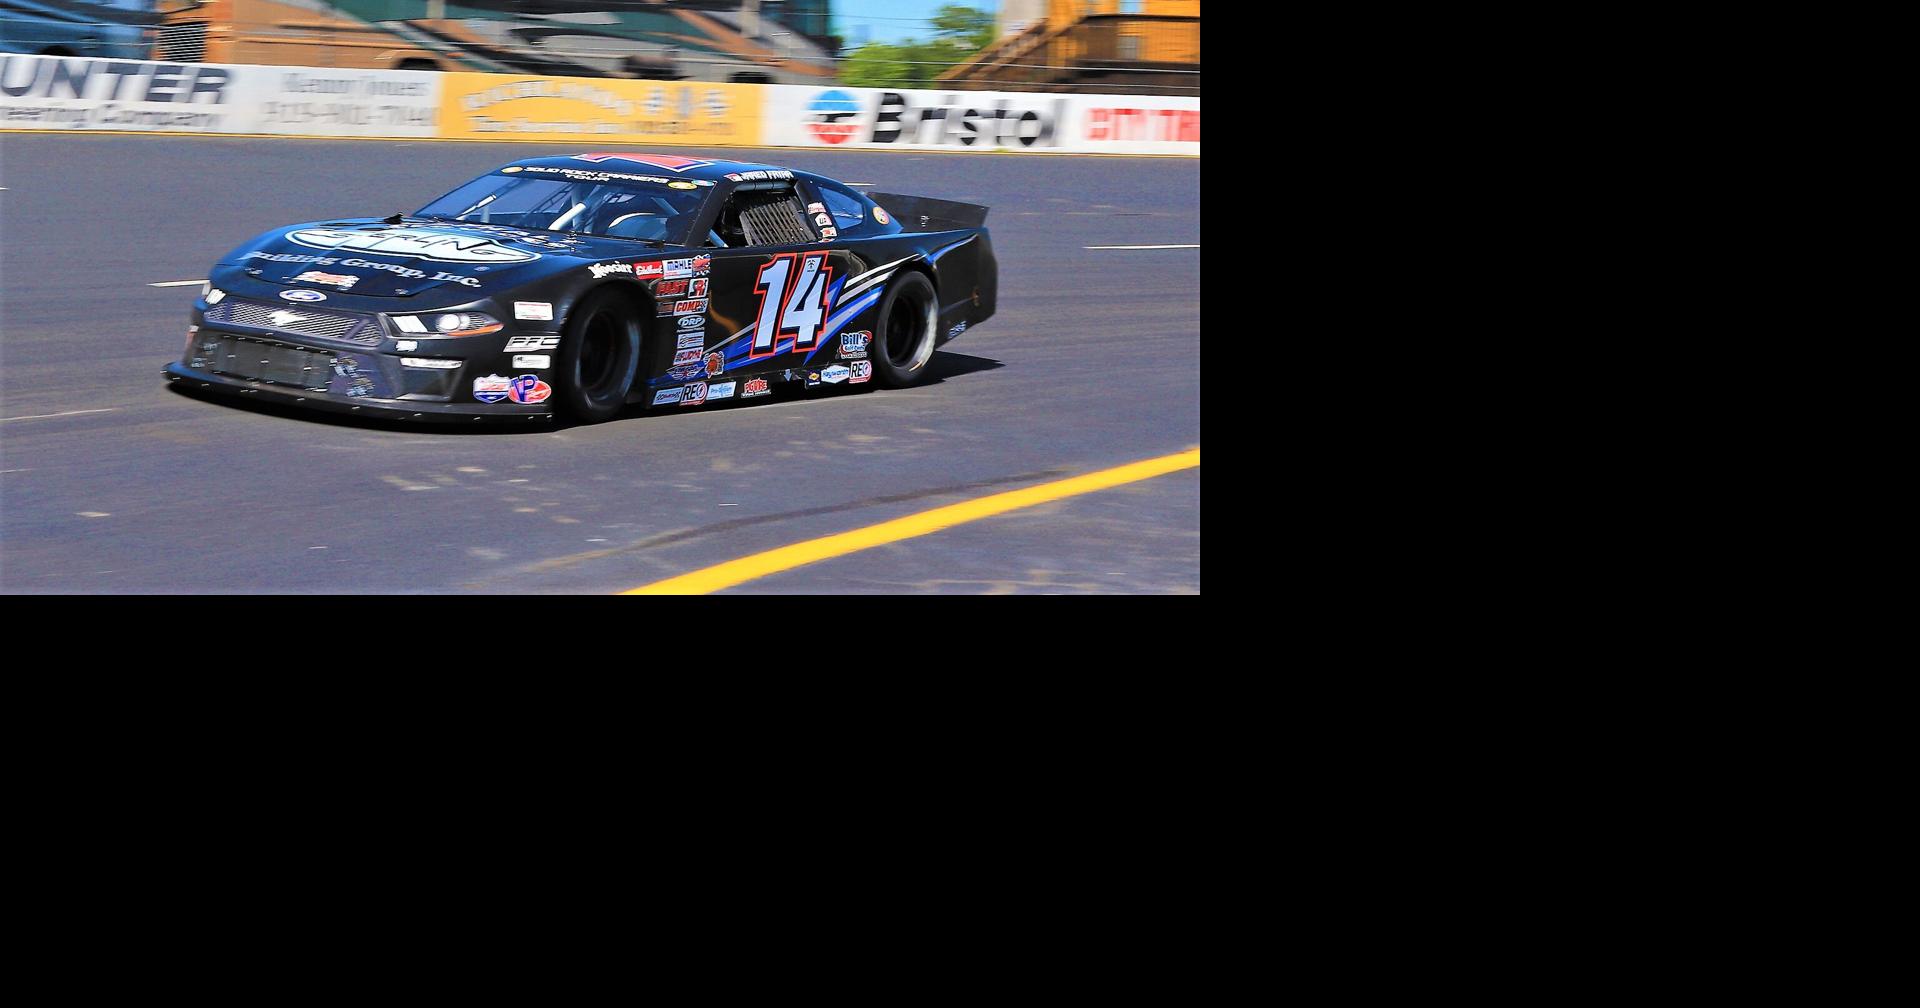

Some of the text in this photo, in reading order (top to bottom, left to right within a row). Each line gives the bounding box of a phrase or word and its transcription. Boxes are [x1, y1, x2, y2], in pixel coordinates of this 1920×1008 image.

[871, 92, 1067, 148] Bristol
[560, 168, 598, 177] ROCK
[597, 172, 670, 184] CARRIERS
[564, 173, 610, 182] TOUR
[667, 260, 692, 271] MAHLE
[339, 258, 426, 279] Group,
[427, 270, 483, 288] Inc.
[676, 302, 700, 313] COMP
[750, 251, 832, 357] 14
[681, 316, 703, 326] DRP
[841, 333, 869, 346] Bill's
